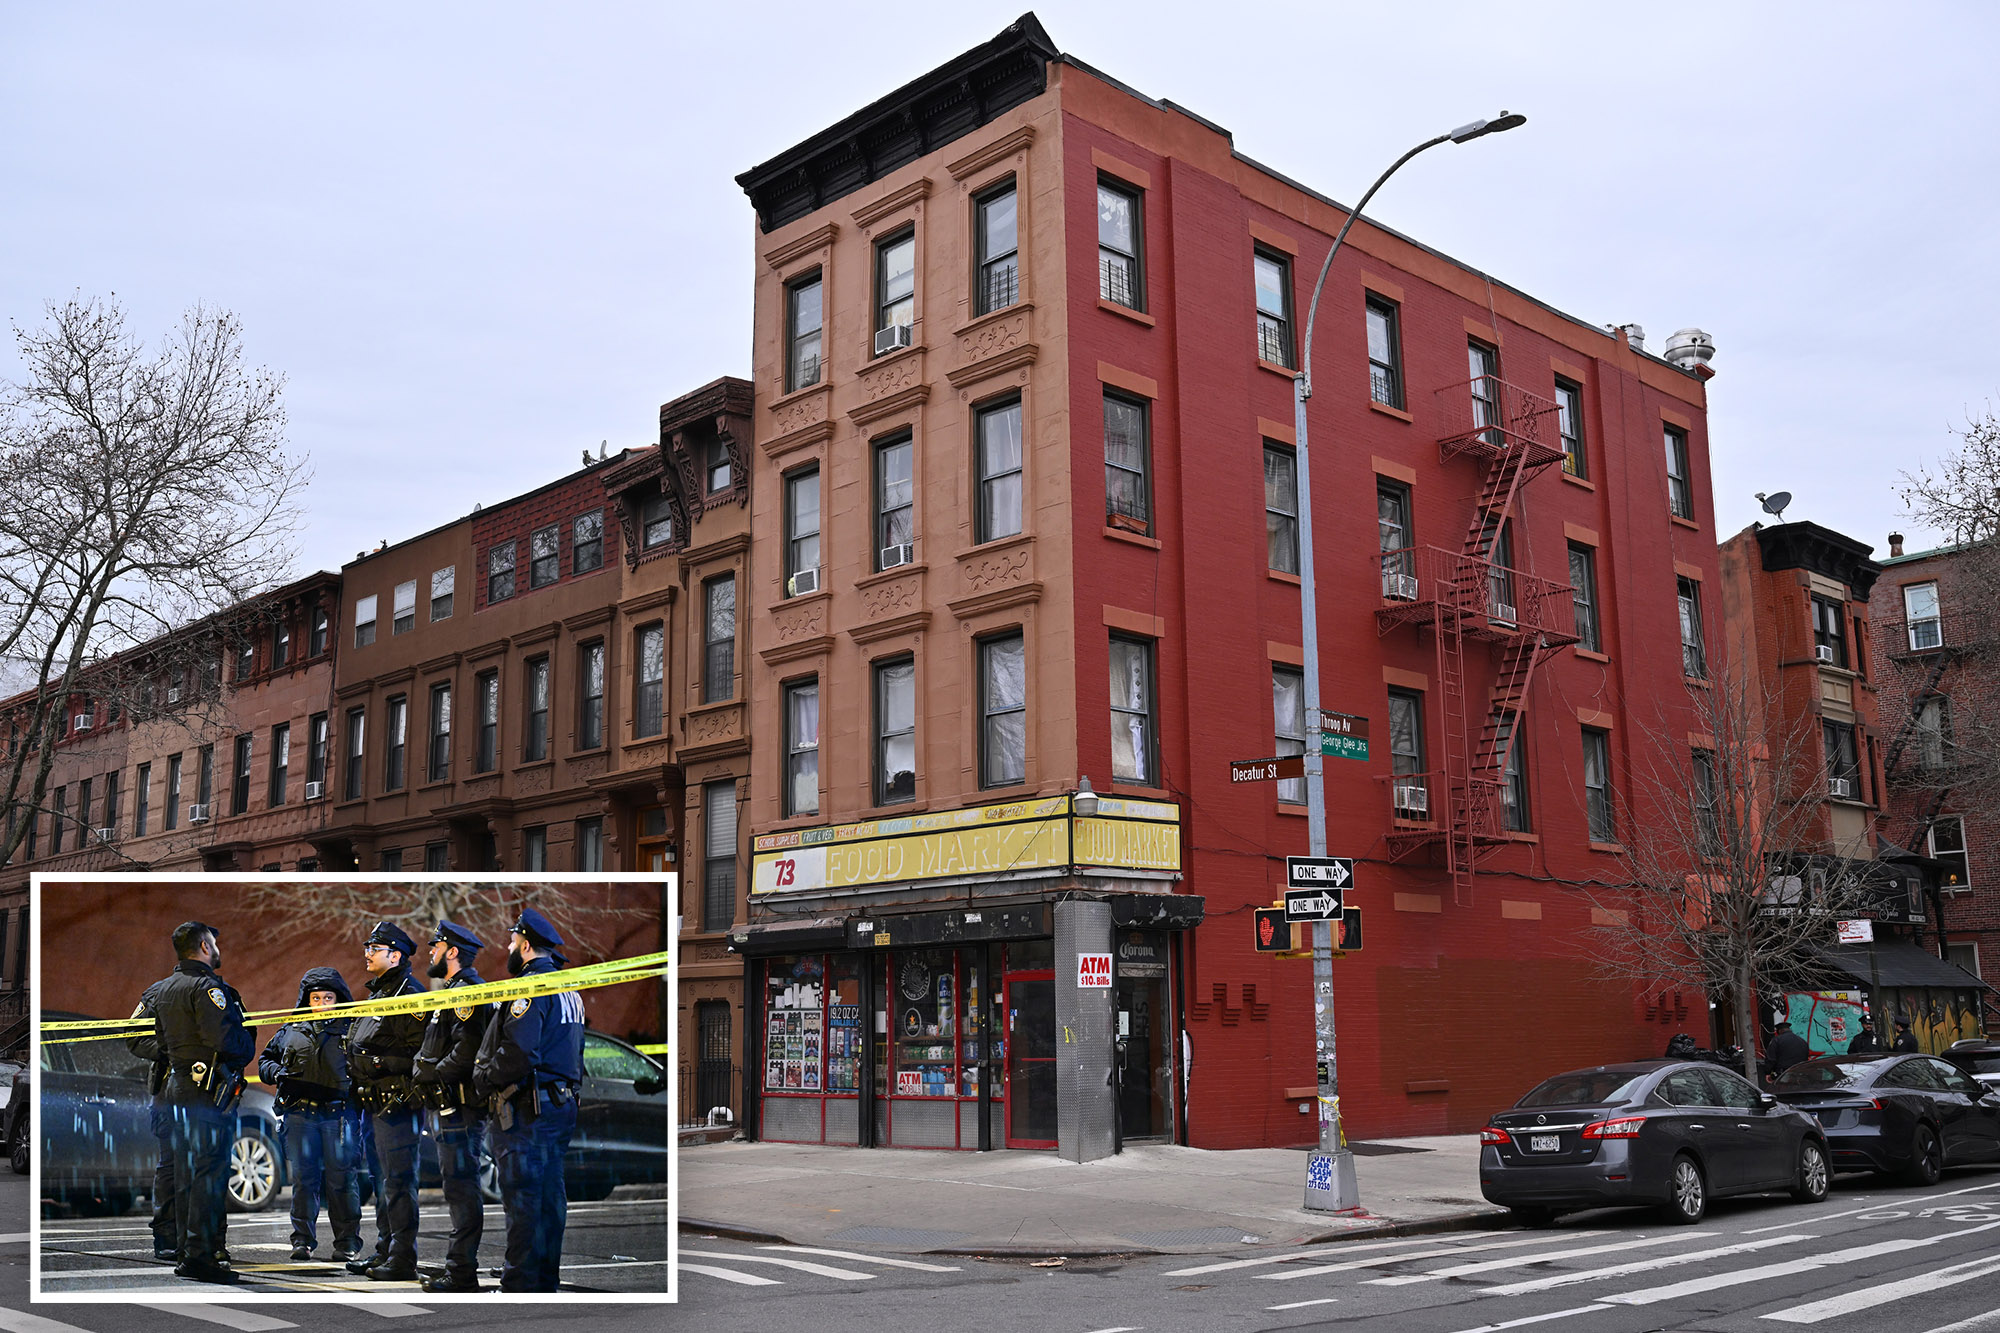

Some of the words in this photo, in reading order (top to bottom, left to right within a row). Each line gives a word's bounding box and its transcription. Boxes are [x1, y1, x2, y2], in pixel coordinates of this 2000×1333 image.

[1321, 713, 1340, 733] Throop
[1342, 718, 1350, 732] Av
[1321, 733, 1341, 750] George
[1343, 737, 1355, 750] Glee
[1233, 766, 1265, 781] Decatur
[1267, 764, 1277, 778] St
[758, 837, 775, 849] SCHOOL
[776, 833, 799, 847] SUPPLIES
[803, 831, 817, 843] FRUIT
[1075, 819, 1116, 863] FOOD
[1120, 823, 1179, 867] MARKET
[826, 844, 904, 885] FOOD
[917, 823, 1063, 876] MARKET
[774, 859, 796, 887] 73
[1298, 867, 1317, 878] ONE
[1325, 868, 1343, 879] WAY
[1293, 900, 1308, 912] ONE
[1313, 899, 1331, 910] WAY
[1120, 943, 1154, 959] Corona
[1080, 957, 1110, 974] ATM
[1097, 976, 1110, 985] Bills
[830, 1007, 841, 1019] 19.2
[843, 1007, 851, 1019] OZ
[899, 1073, 921, 1085] ATM
[1309, 1167, 1332, 1177] 4CASH
[1311, 1161, 1330, 1169] CAR
